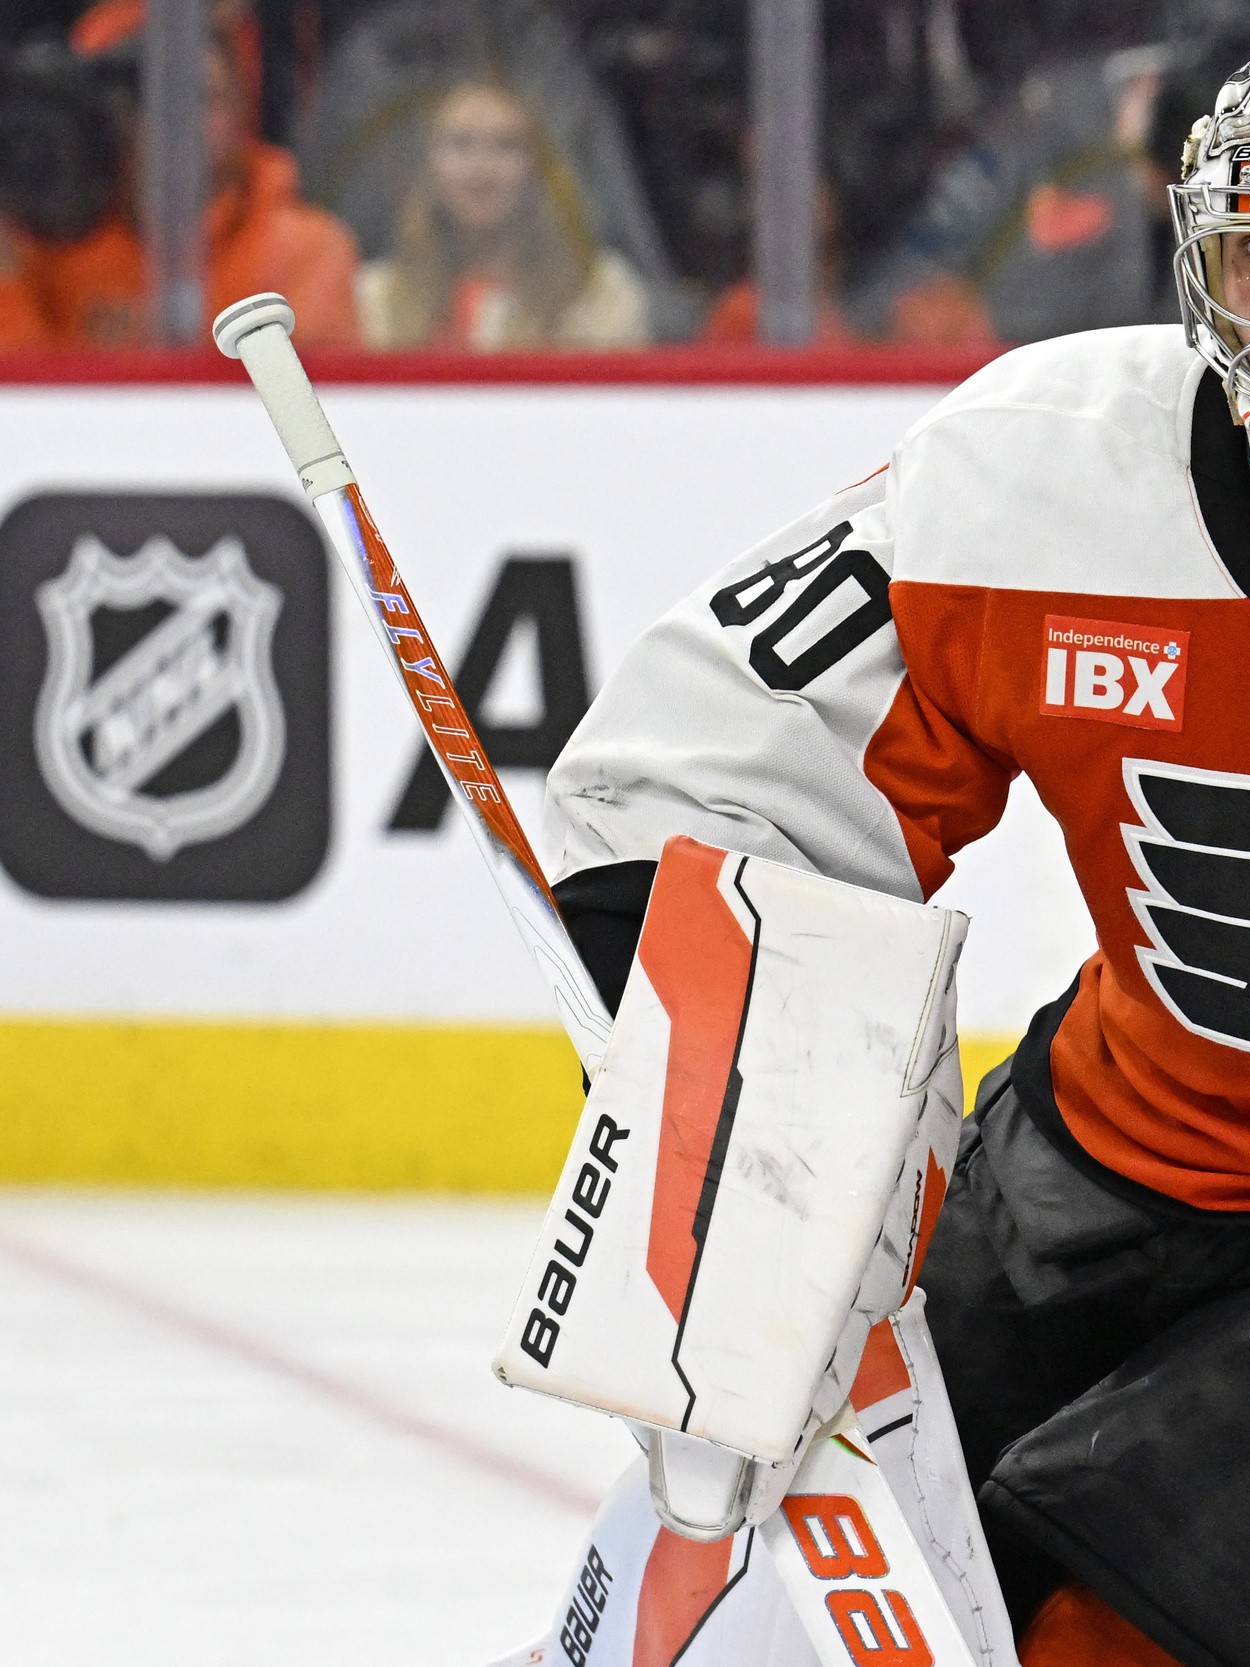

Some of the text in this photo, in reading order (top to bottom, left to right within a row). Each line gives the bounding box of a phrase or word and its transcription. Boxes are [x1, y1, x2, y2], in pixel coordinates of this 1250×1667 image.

[709, 520, 894, 691] 80
[1048, 628, 1160, 654] Independence
[364, 582, 501, 804] FLYLITE
[1045, 648, 1179, 720] IBX
[520, 1113, 631, 1369] BAUER
[559, 1543, 614, 1667] BAUER
